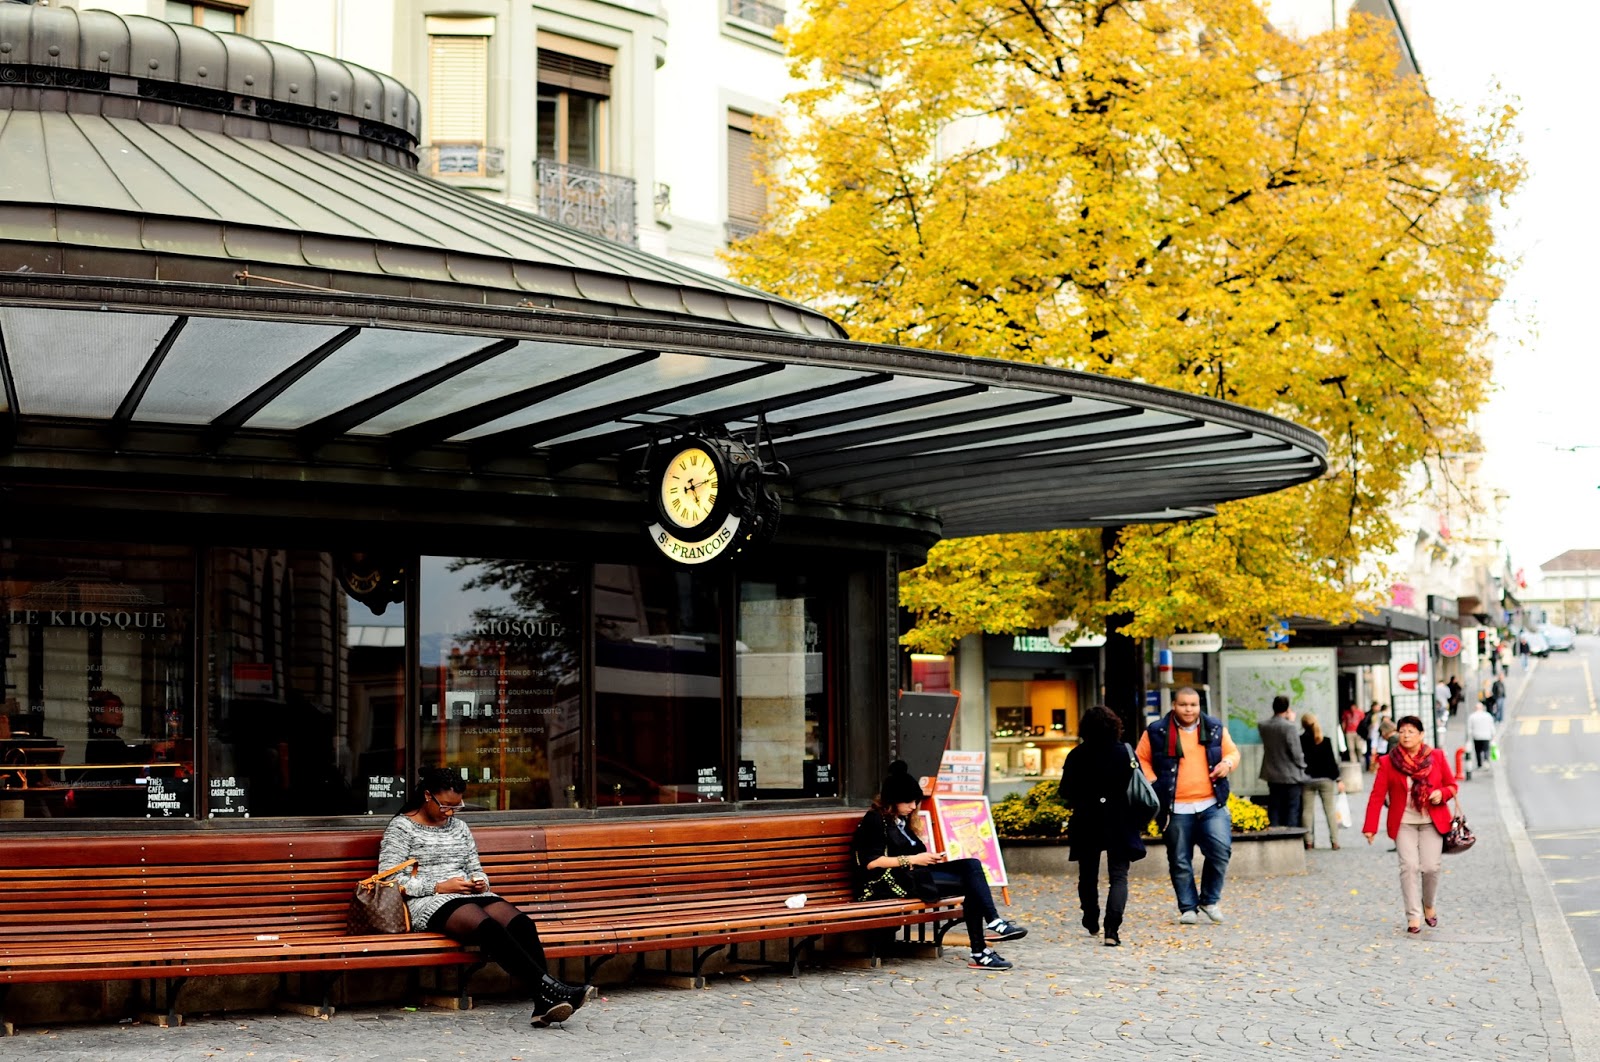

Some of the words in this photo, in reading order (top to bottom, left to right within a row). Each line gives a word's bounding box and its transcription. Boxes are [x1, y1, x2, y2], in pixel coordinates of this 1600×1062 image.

[9, 609, 40, 625] LE
[50, 610, 166, 631] KIOSQUE
[475, 620, 561, 639] KIOSQUE
[489, 668, 522, 677] SÉLECTION
[210, 779, 221, 787] LES
[995, 924, 1008, 933] N
[979, 956, 993, 965] N
